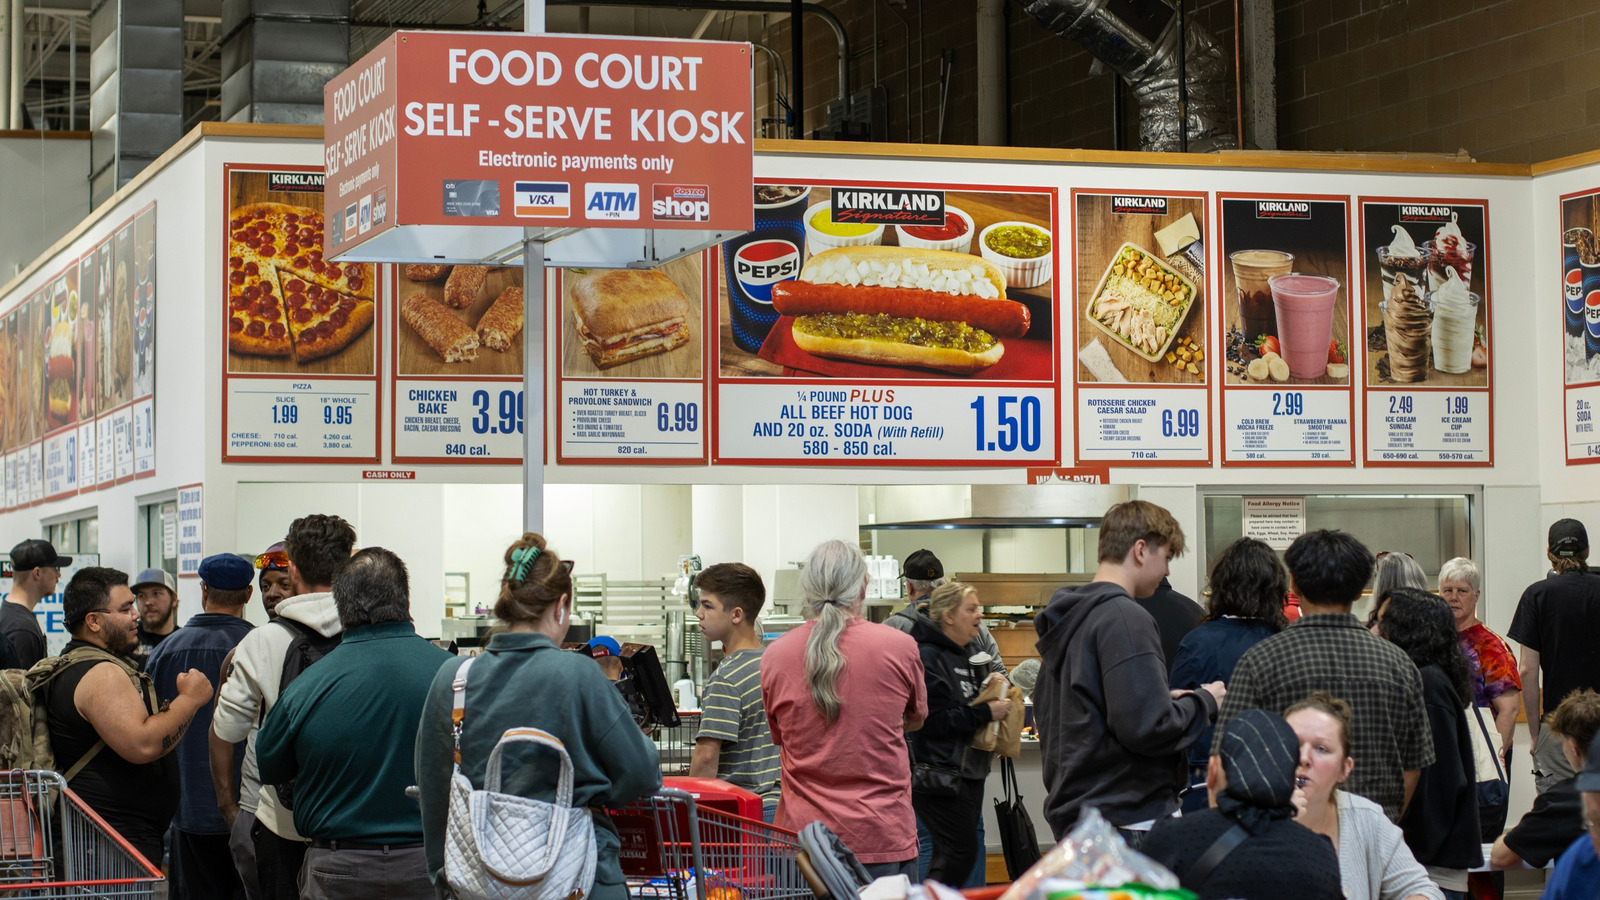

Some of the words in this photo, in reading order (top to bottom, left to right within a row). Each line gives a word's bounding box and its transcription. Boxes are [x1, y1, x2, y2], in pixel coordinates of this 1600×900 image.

[449, 49, 562, 86] FOOD
[575, 52, 702, 91] COURT
[334, 80, 356, 124] FOOD
[359, 57, 386, 107] COURT
[370, 105, 395, 152] KIOSK
[631, 109, 745, 143] KIOSK
[479, 151, 557, 168] Electronic
[562, 153, 637, 173] payments
[641, 156, 674, 173] only
[272, 174, 324, 185] KIRKLAN
[339, 178, 354, 197] Electronic
[355, 167, 371, 191] payments
[529, 195, 554, 204] VISA
[587, 192, 637, 211] ATM
[838, 191, 940, 211] KIRKLAND
[1115, 198, 1165, 208] KIRKLAND
[1259, 202, 1308, 212] KIRKLAND
[653, 197, 709, 221] shop
[837, 209, 941, 224] Signature
[1402, 206, 1450, 216] KIRKLAND
[738, 258, 797, 278] PEPSI
[1566, 285, 1582, 295] PEP
[1586, 307, 1600, 318] PEP
[409, 390, 457, 402] CHICKEN
[569, 398, 611, 406] PROVOLONE
[614, 398, 652, 406] SANDWICH
[810, 391, 847, 402] POUND
[850, 390, 895, 403] PLUS
[1273, 393, 1303, 415] 2.99
[418, 403, 447, 414] BAKE
[780, 405, 806, 419] ALL
[812, 405, 845, 419] BEEF
[850, 406, 878, 420] HOT
[884, 406, 913, 420] DOG
[1390, 396, 1412, 414] 2.49
[1446, 397, 1468, 414] 1.99
[1576, 400, 1583, 410] 20
[272, 405, 298, 424] 1.99
[324, 405, 352, 424] 9.95
[658, 402, 698, 432] 6.99
[1162, 409, 1199, 437] 6.99
[1577, 411, 1591, 422] SODA
[753, 422, 782, 436] AND
[788, 423, 804, 437] 20
[810, 426, 828, 437] oz.
[834, 423, 872, 438] SODA
[878, 426, 907, 440] (With
[911, 427, 944, 440] Refill)
[971, 396, 1041, 452] 1.50
[446, 444, 466, 455] 840
[470, 444, 490, 455] cal.
[803, 441, 828, 455] 580
[844, 441, 868, 455] 850
[874, 442, 896, 455] cal.
